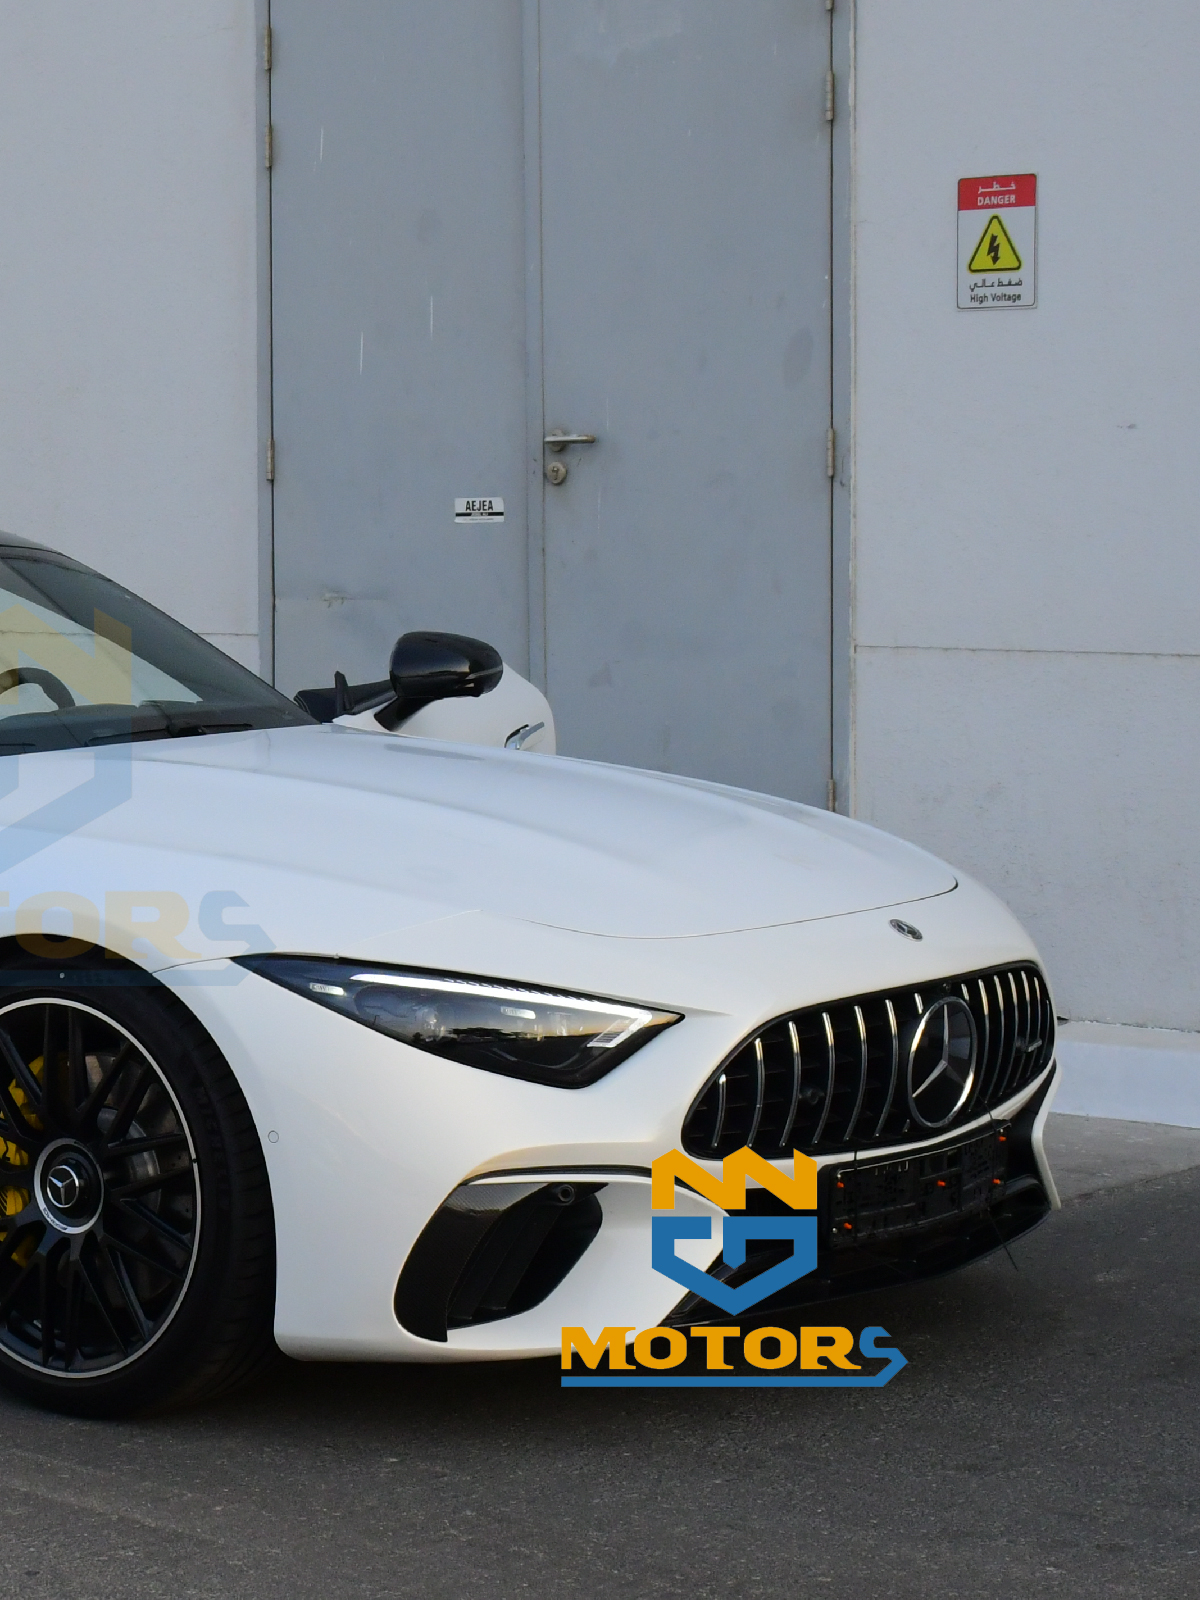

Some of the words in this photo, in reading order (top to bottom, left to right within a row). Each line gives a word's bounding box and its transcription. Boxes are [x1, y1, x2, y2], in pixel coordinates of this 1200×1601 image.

[977, 195, 1016, 206] DANGER
[969, 279, 995, 292] عالي
[997, 278, 1023, 287] ضغط
[970, 293, 988, 305] High
[990, 292, 1022, 303] Voltage
[465, 500, 494, 511] AEJEA
